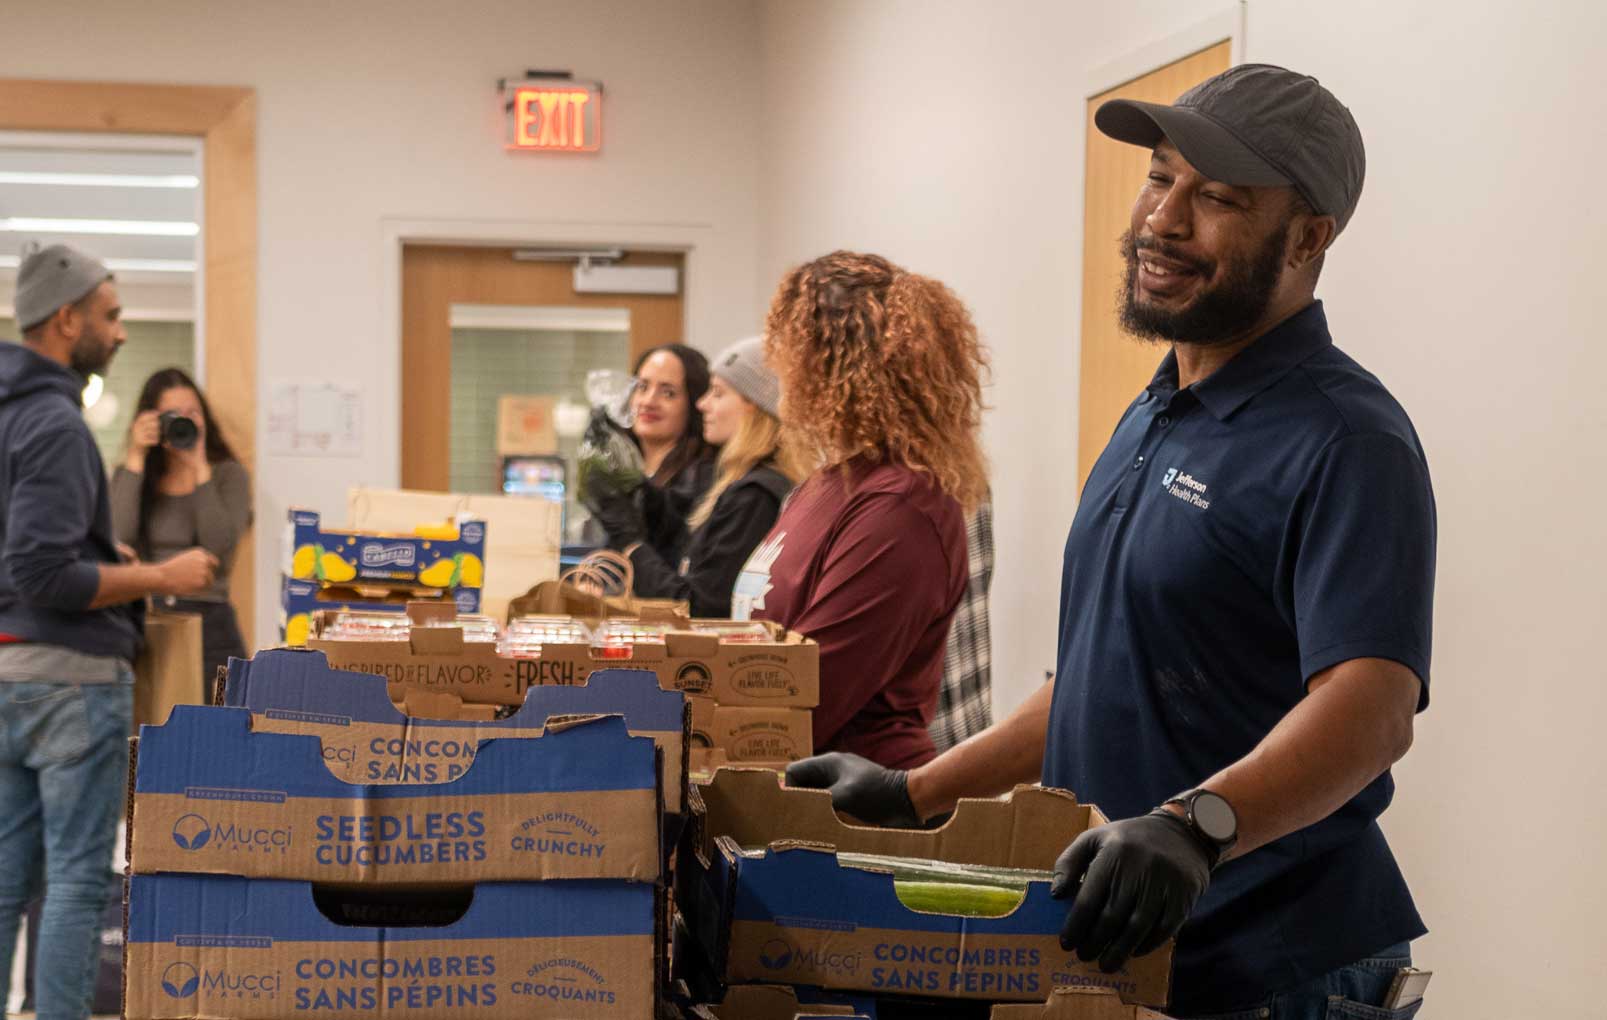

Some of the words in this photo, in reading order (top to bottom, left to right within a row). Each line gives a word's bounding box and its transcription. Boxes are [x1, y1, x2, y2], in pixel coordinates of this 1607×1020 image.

[517, 91, 589, 147] EXIT
[1175, 471, 1207, 494] Jefferson
[1168, 483, 1192, 503] Health
[1189, 493, 1210, 510] Plans
[416, 664, 485, 685] FLAVOR
[516, 660, 574, 694] FRESH
[322, 745, 356, 762] cci
[370, 738, 475, 759] CONCOM
[368, 761, 438, 782] SANS
[214, 822, 292, 846] Mucci
[316, 811, 486, 842] SEEDLESS
[521, 812, 599, 837] DELIGHTFULLY
[315, 840, 487, 866] CUCUMBERS
[511, 836, 605, 858] CRUNCHY
[793, 944, 863, 971] Mucci
[873, 942, 1041, 967] CONCOMBRES
[295, 955, 496, 980] CONCOMBRES
[871, 966, 940, 991] SANS
[203, 969, 281, 992] Mucci
[511, 981, 616, 1005] CROQUANTS
[295, 986, 377, 1010] SANS
[388, 979, 497, 1009] PÉPINS
